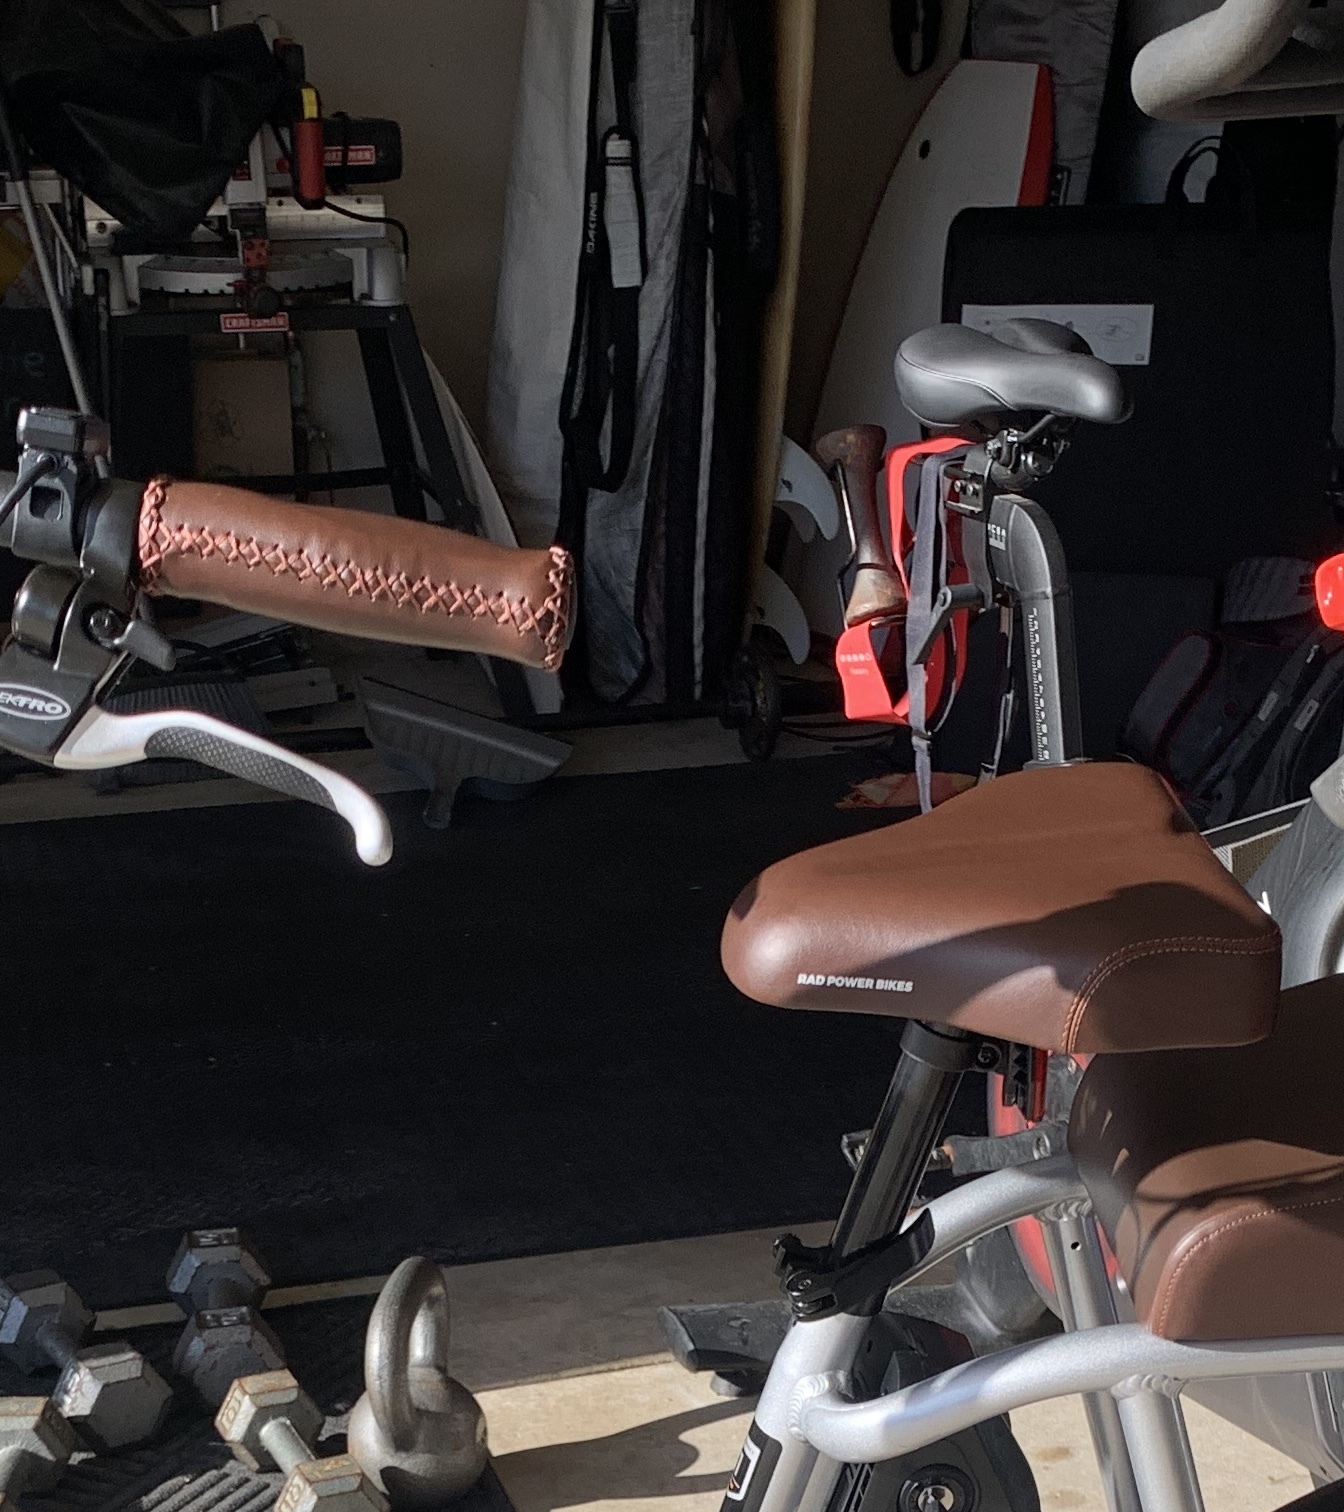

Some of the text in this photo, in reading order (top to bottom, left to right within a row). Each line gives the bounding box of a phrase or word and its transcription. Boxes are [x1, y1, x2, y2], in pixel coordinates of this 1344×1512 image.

[797, 973, 914, 993] RAD POWER BIKES
